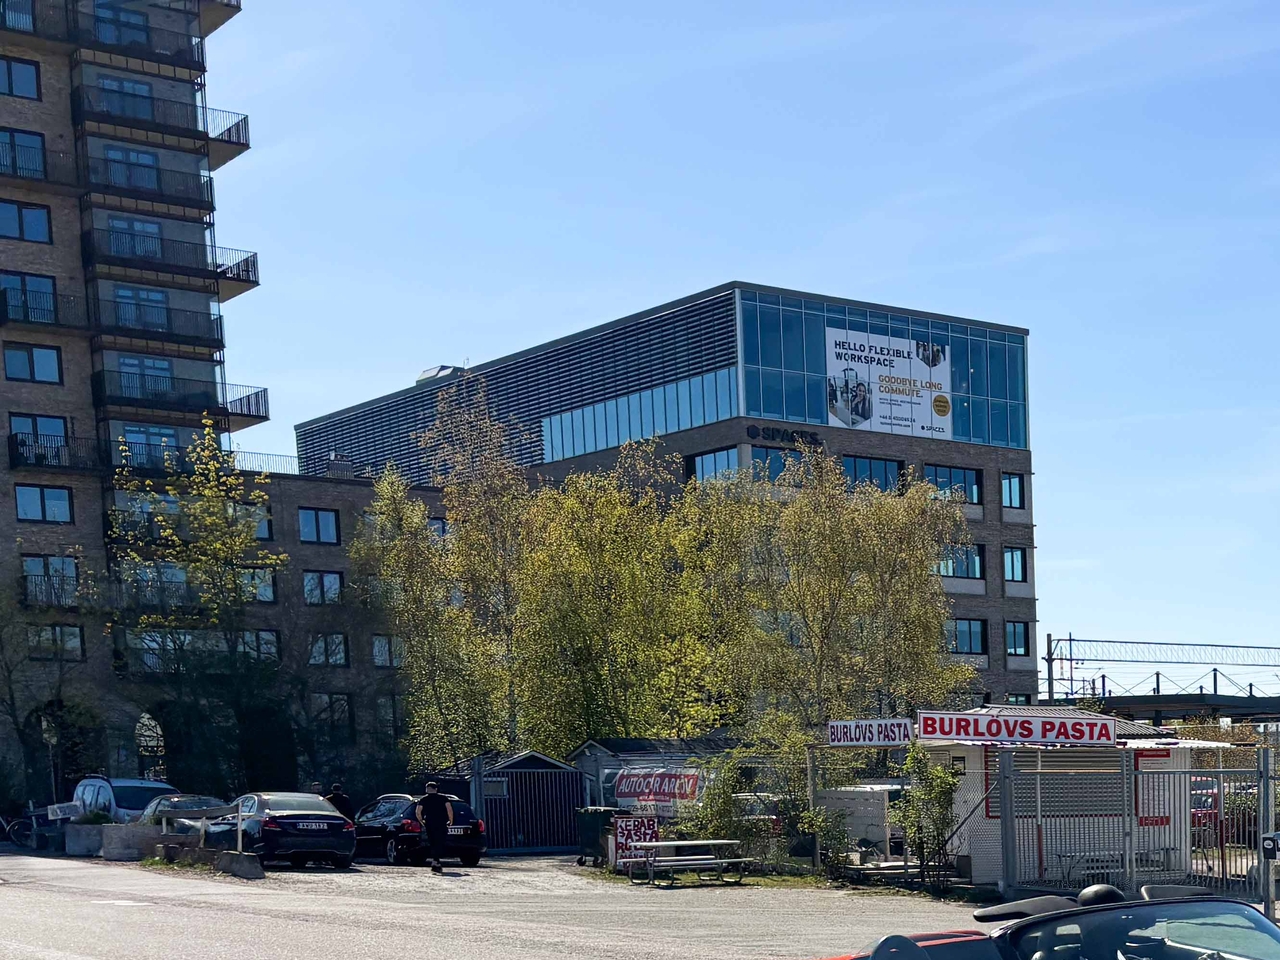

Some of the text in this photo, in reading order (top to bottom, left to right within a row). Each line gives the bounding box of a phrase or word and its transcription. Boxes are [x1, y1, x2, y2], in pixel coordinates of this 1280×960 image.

[834, 340, 913, 360] HELLO FLEXIBLE
[835, 351, 895, 368] WORKSPACE
[878, 374, 943, 391] GOODBYE LONG
[829, 720, 911, 744] BURLÖVS PASTA
[922, 715, 1112, 741] BURLÖVS PASTA
[617, 818, 656, 831] KEBAB
